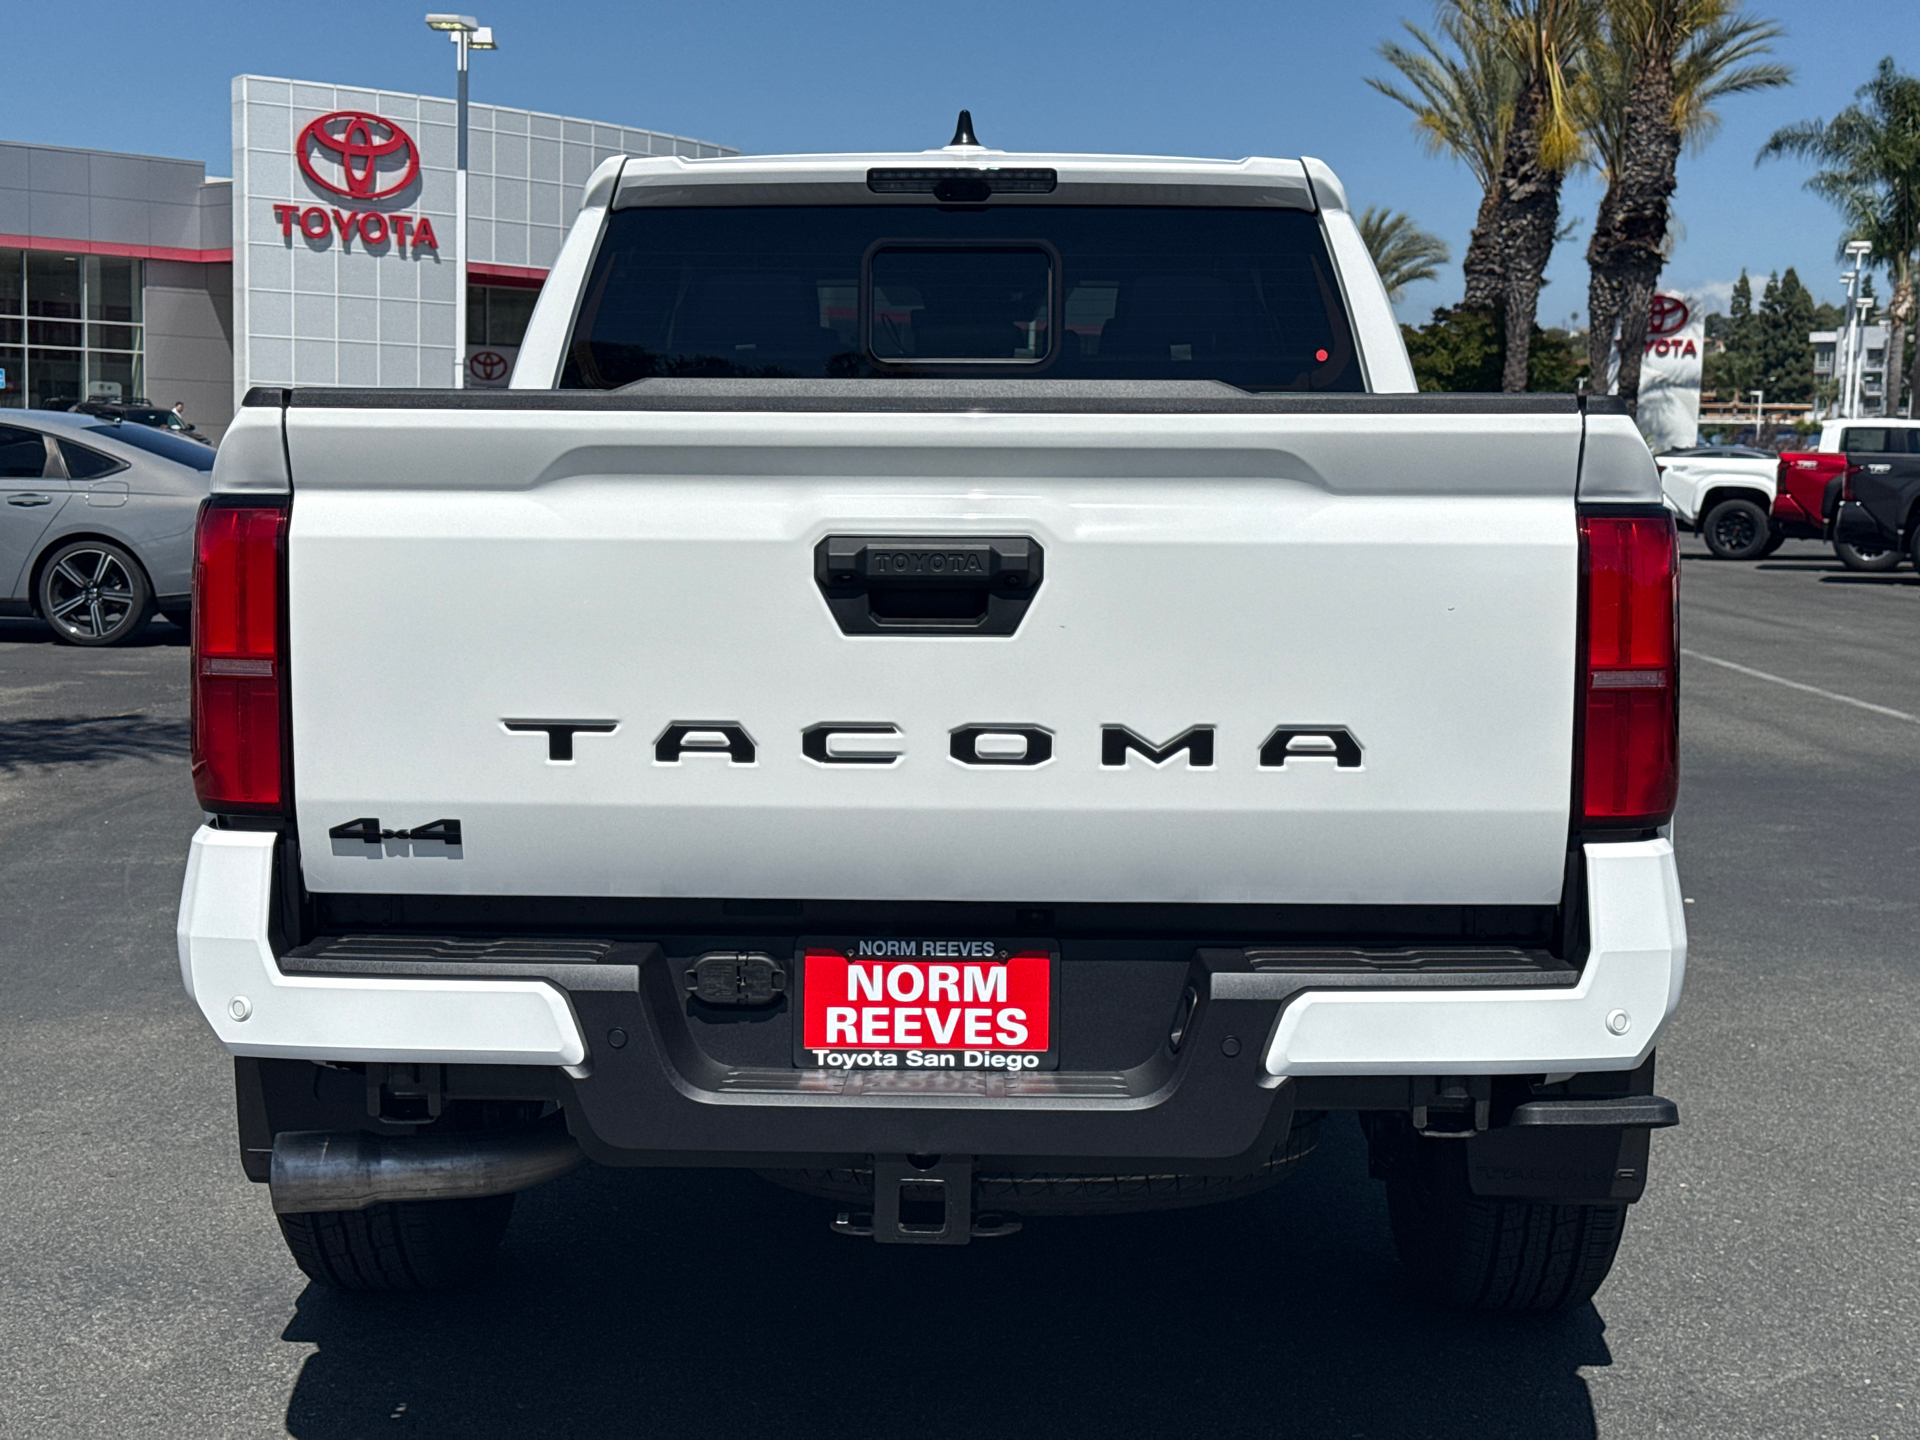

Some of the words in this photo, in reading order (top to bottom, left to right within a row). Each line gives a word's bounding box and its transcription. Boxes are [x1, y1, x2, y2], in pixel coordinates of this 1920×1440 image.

[273, 204, 439, 249] TOYOTA
[874, 552, 983, 573] TOYOTA
[499, 718, 1366, 770] TACOMA
[858, 940, 917, 956] NORM
[922, 941, 995, 957] REEVES
[847, 964, 1008, 1003] NORM
[826, 1006, 1029, 1046] REEVES
[812, 1049, 898, 1070] Toyota
[905, 1050, 955, 1067] San
[964, 1051, 1039, 1071] Diego
